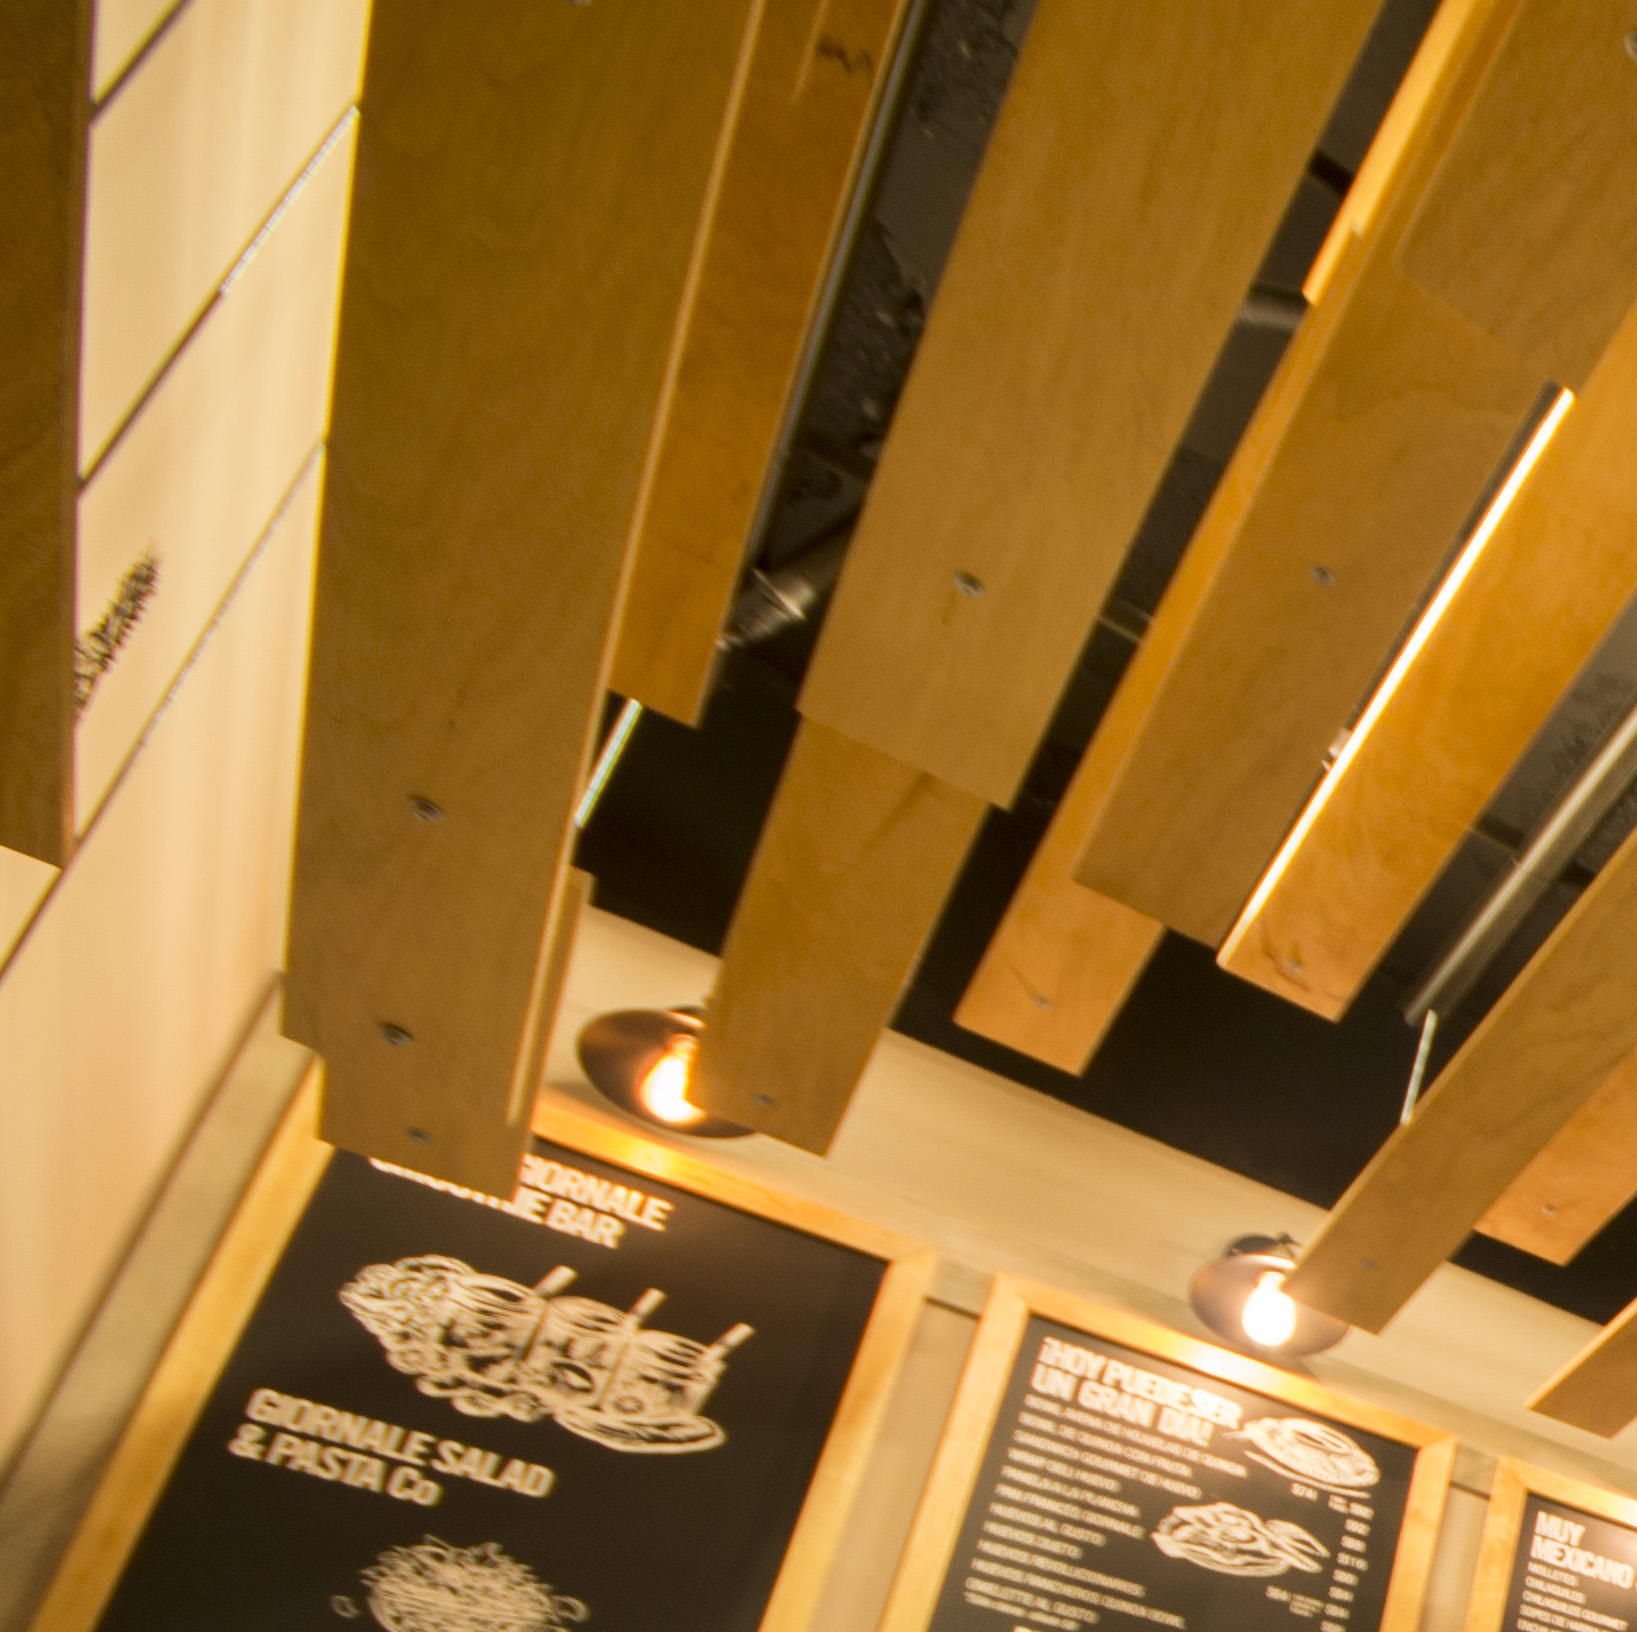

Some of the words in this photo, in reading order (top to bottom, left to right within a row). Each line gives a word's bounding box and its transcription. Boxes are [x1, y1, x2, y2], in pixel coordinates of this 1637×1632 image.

[519, 1152, 674, 1231] IORNALE
[546, 1195, 626, 1249] BAR
[1028, 1362, 1079, 1403] UN
[1075, 1378, 1157, 1429] GRAN
[1100, 1357, 1193, 1413] PUEDE
[1186, 1387, 1245, 1430] SER
[224, 1421, 271, 1462] &
[262, 1431, 388, 1492] PASTA
[240, 1386, 436, 1467] GIORNALE
[428, 1436, 560, 1500] SALAD
[1529, 1533, 1636, 1591] MEXICANO
[1533, 1509, 1586, 1549] MUY
